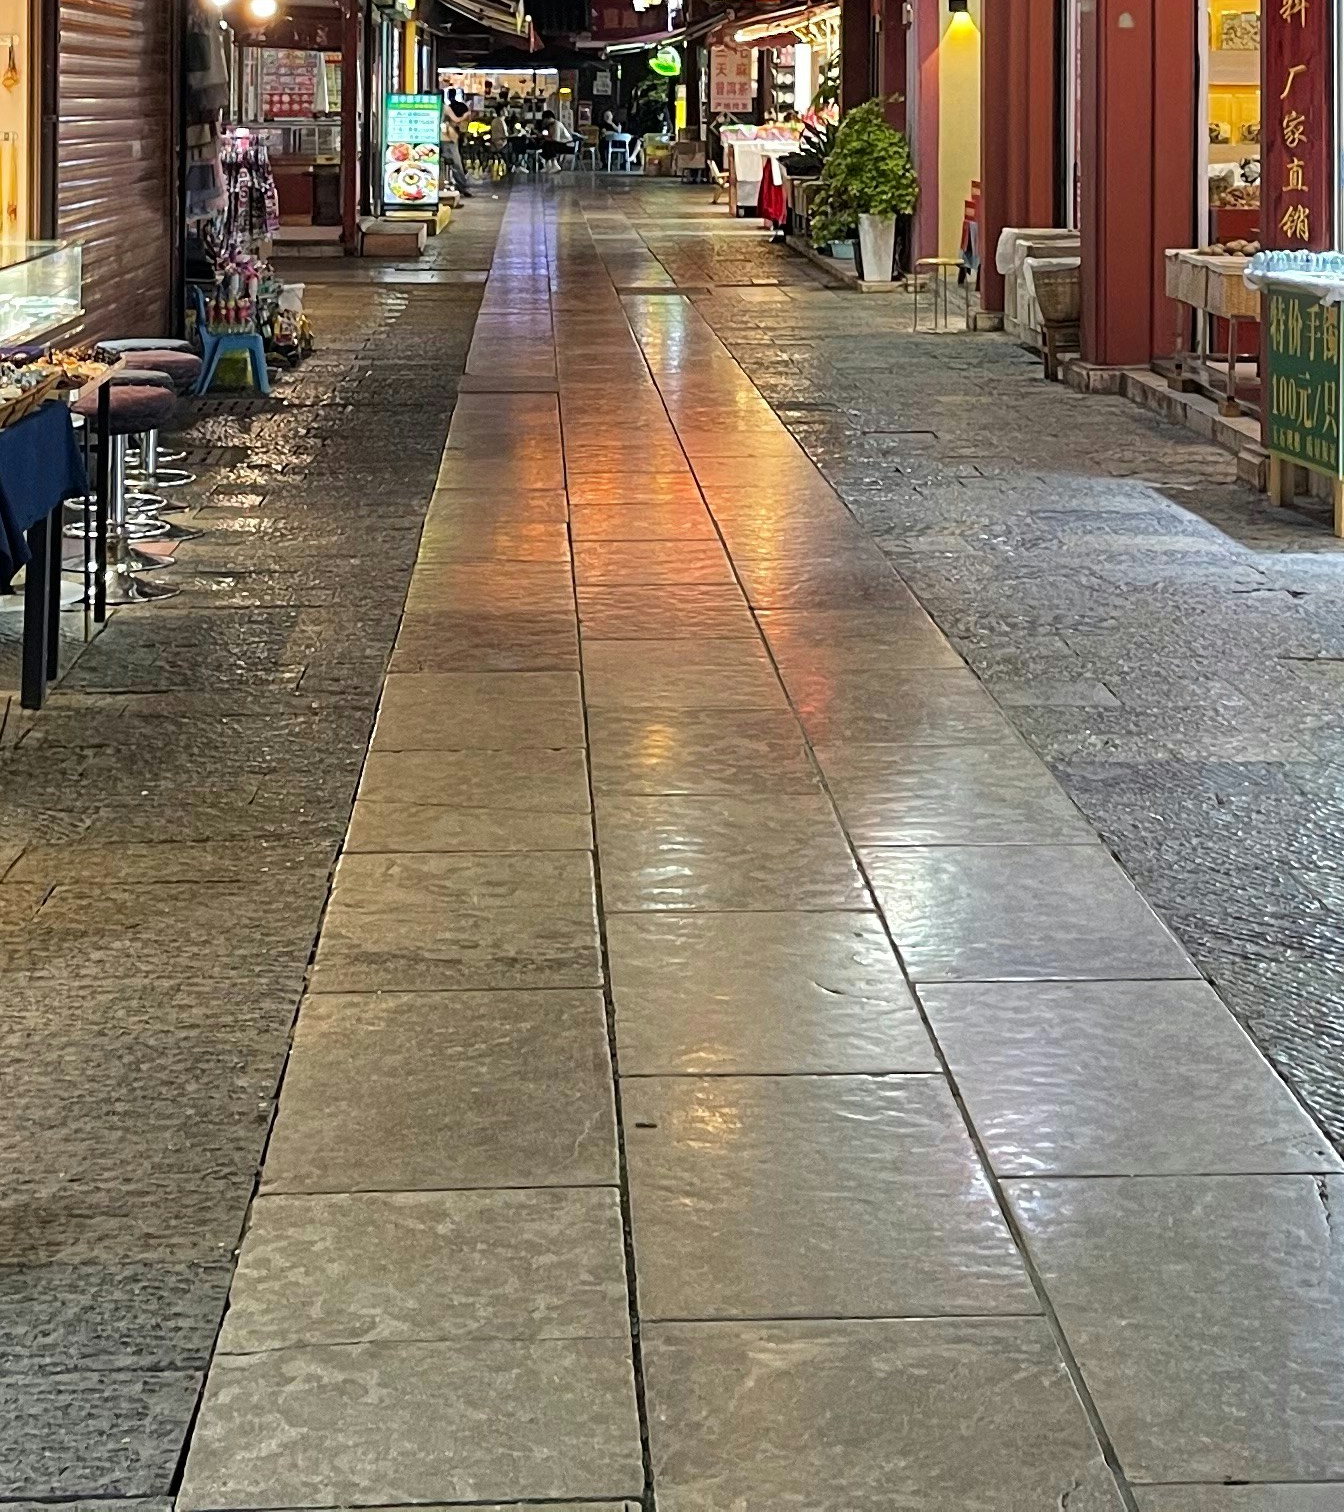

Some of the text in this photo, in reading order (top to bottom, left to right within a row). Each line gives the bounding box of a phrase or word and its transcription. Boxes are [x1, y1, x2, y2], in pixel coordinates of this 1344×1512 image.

[1279, 63, 1309, 242] 厂家直销
[1272, 371, 1338, 439] 100元/只
